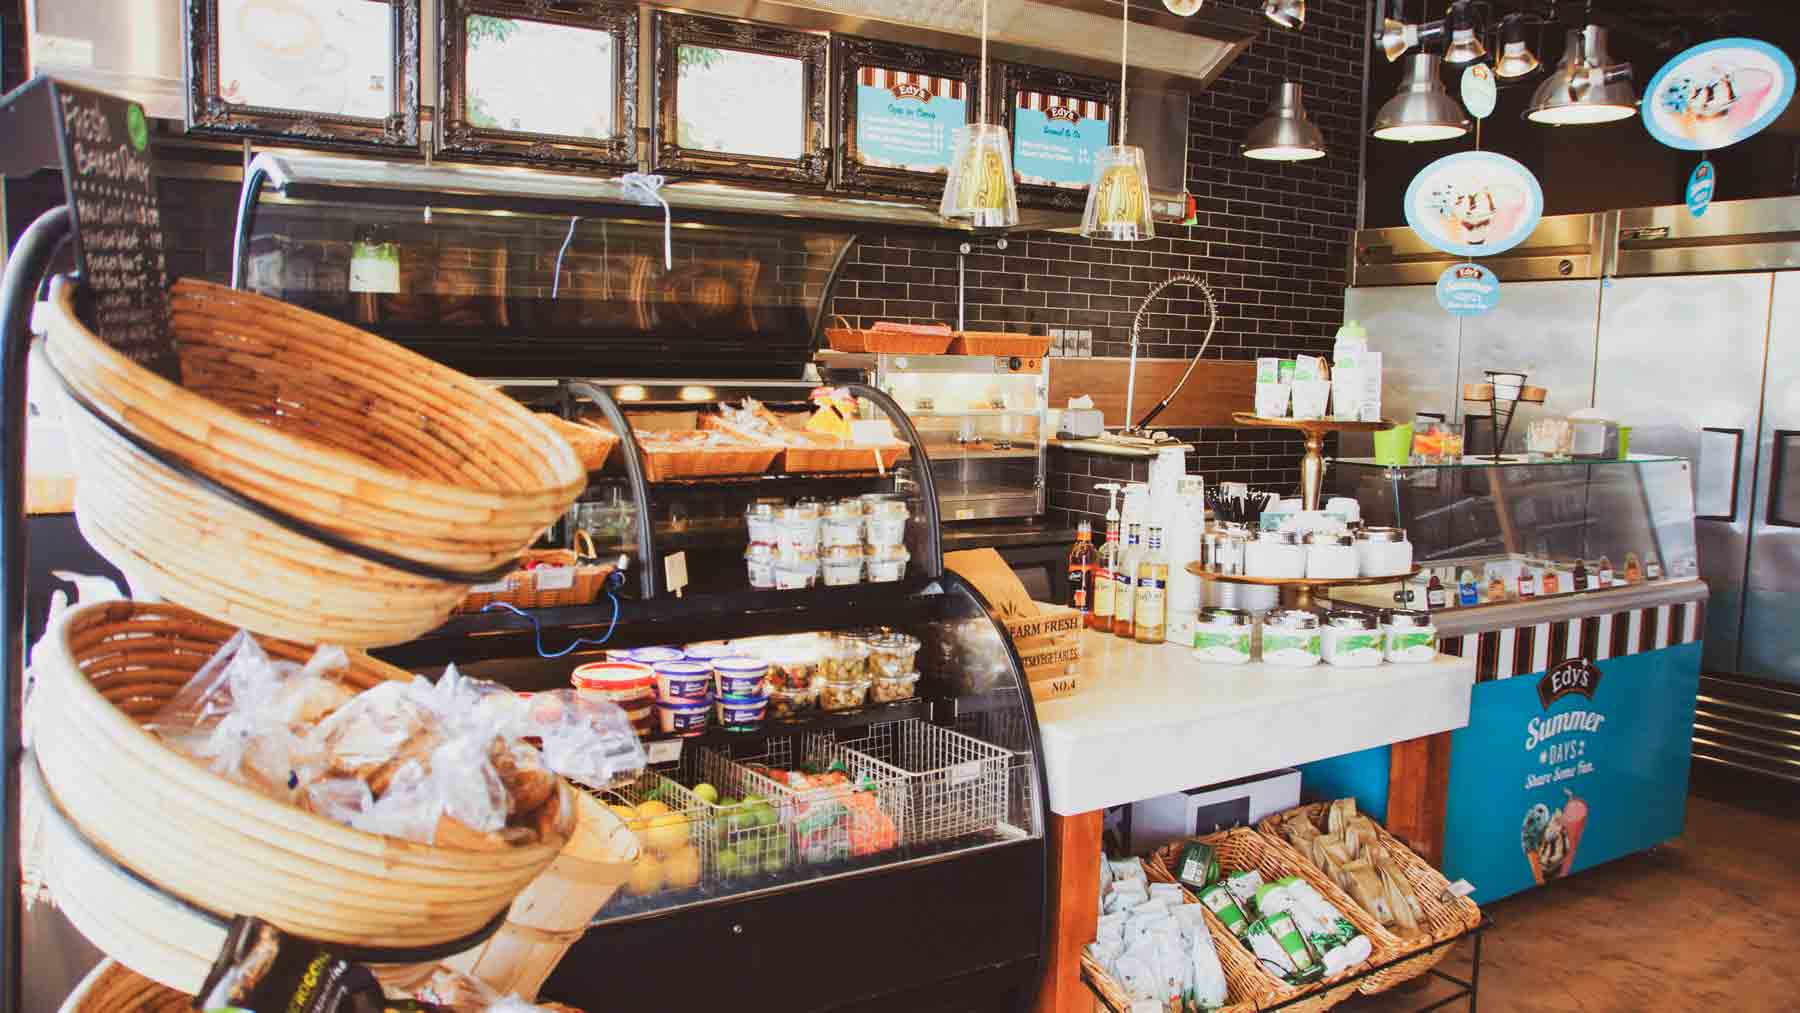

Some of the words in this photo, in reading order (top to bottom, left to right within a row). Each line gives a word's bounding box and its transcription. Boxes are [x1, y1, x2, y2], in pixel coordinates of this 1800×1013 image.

[1010, 623, 1041, 639] FARM
[1043, 616, 1079, 634] FRESH
[1551, 657, 1591, 692] Edy's
[1525, 710, 1604, 751] Summer
[1548, 741, 1578, 766] DAYS
